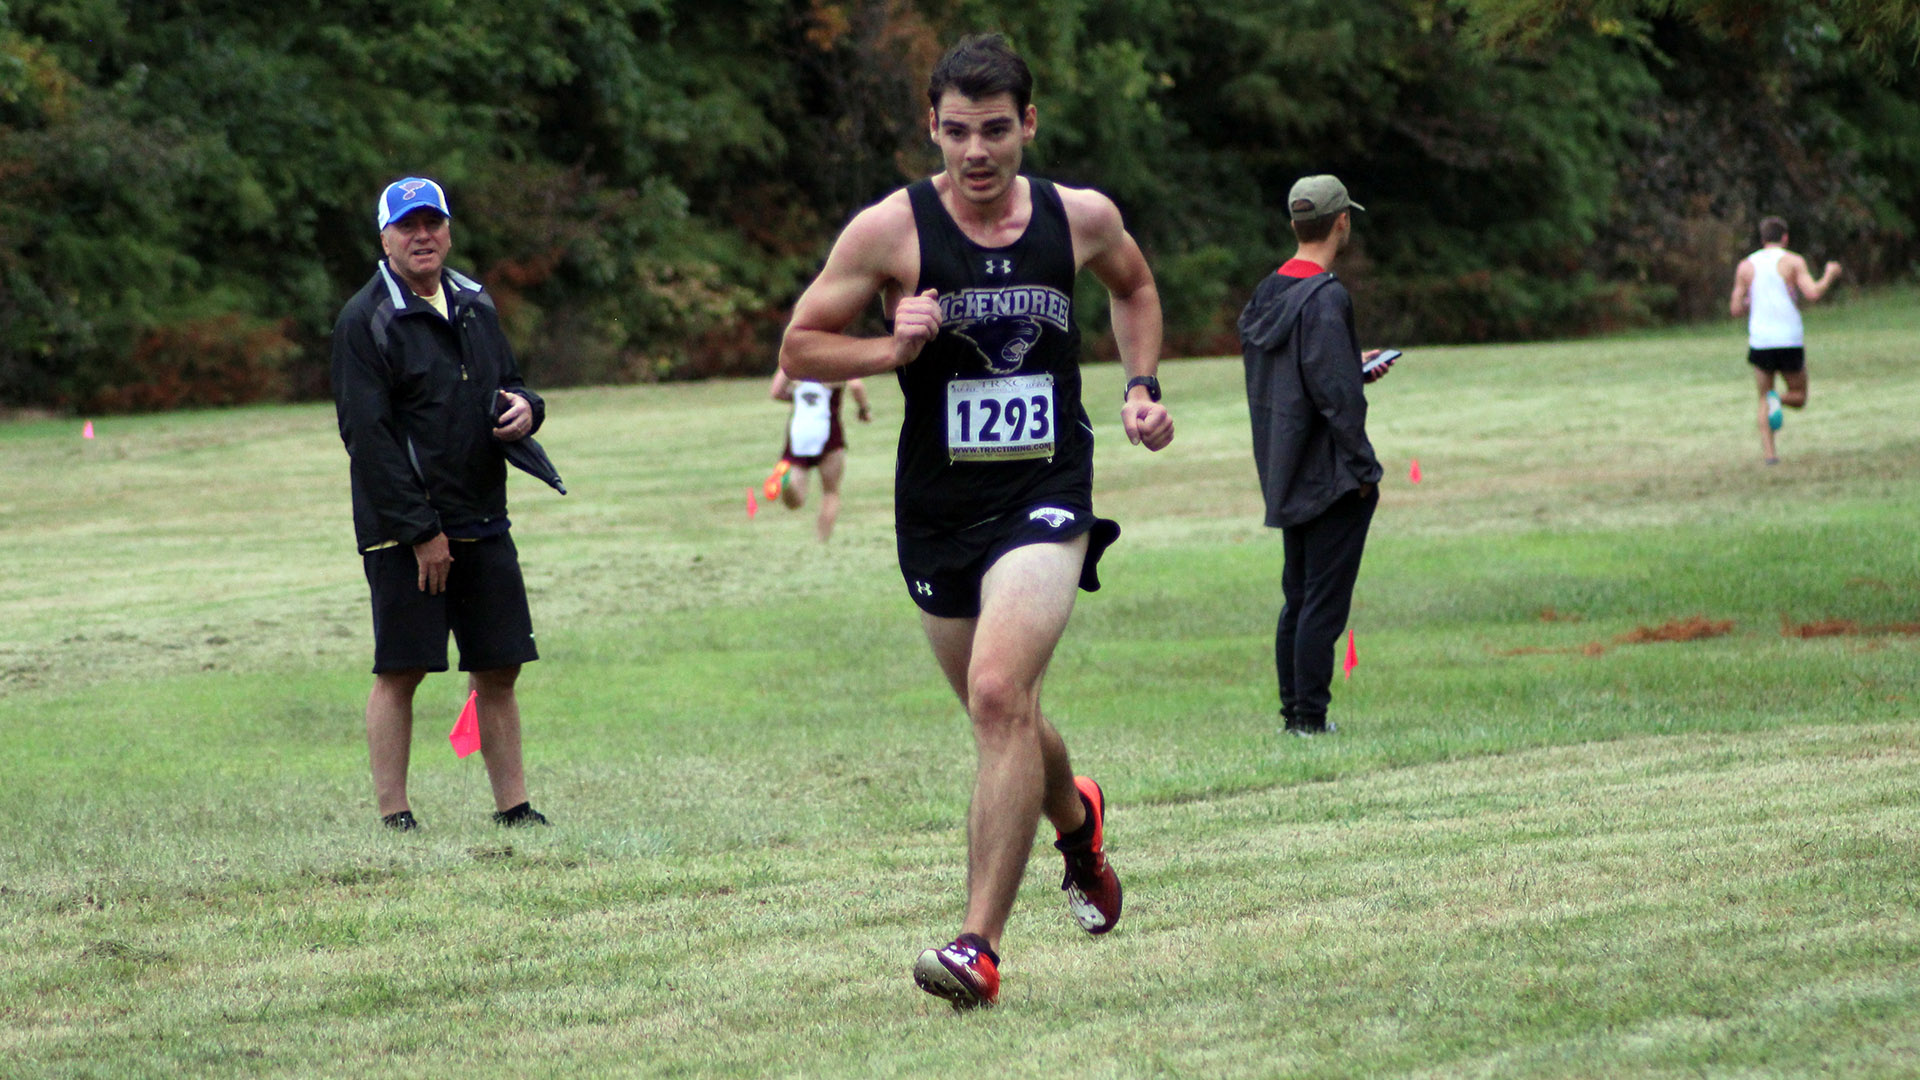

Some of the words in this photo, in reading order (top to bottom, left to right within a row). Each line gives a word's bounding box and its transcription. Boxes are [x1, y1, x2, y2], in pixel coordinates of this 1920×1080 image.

[981, 379, 1018, 388] TRXC
[957, 395, 1050, 442] 1293
[952, 443, 1051, 453] WWW.TRXCTIMING.COM
